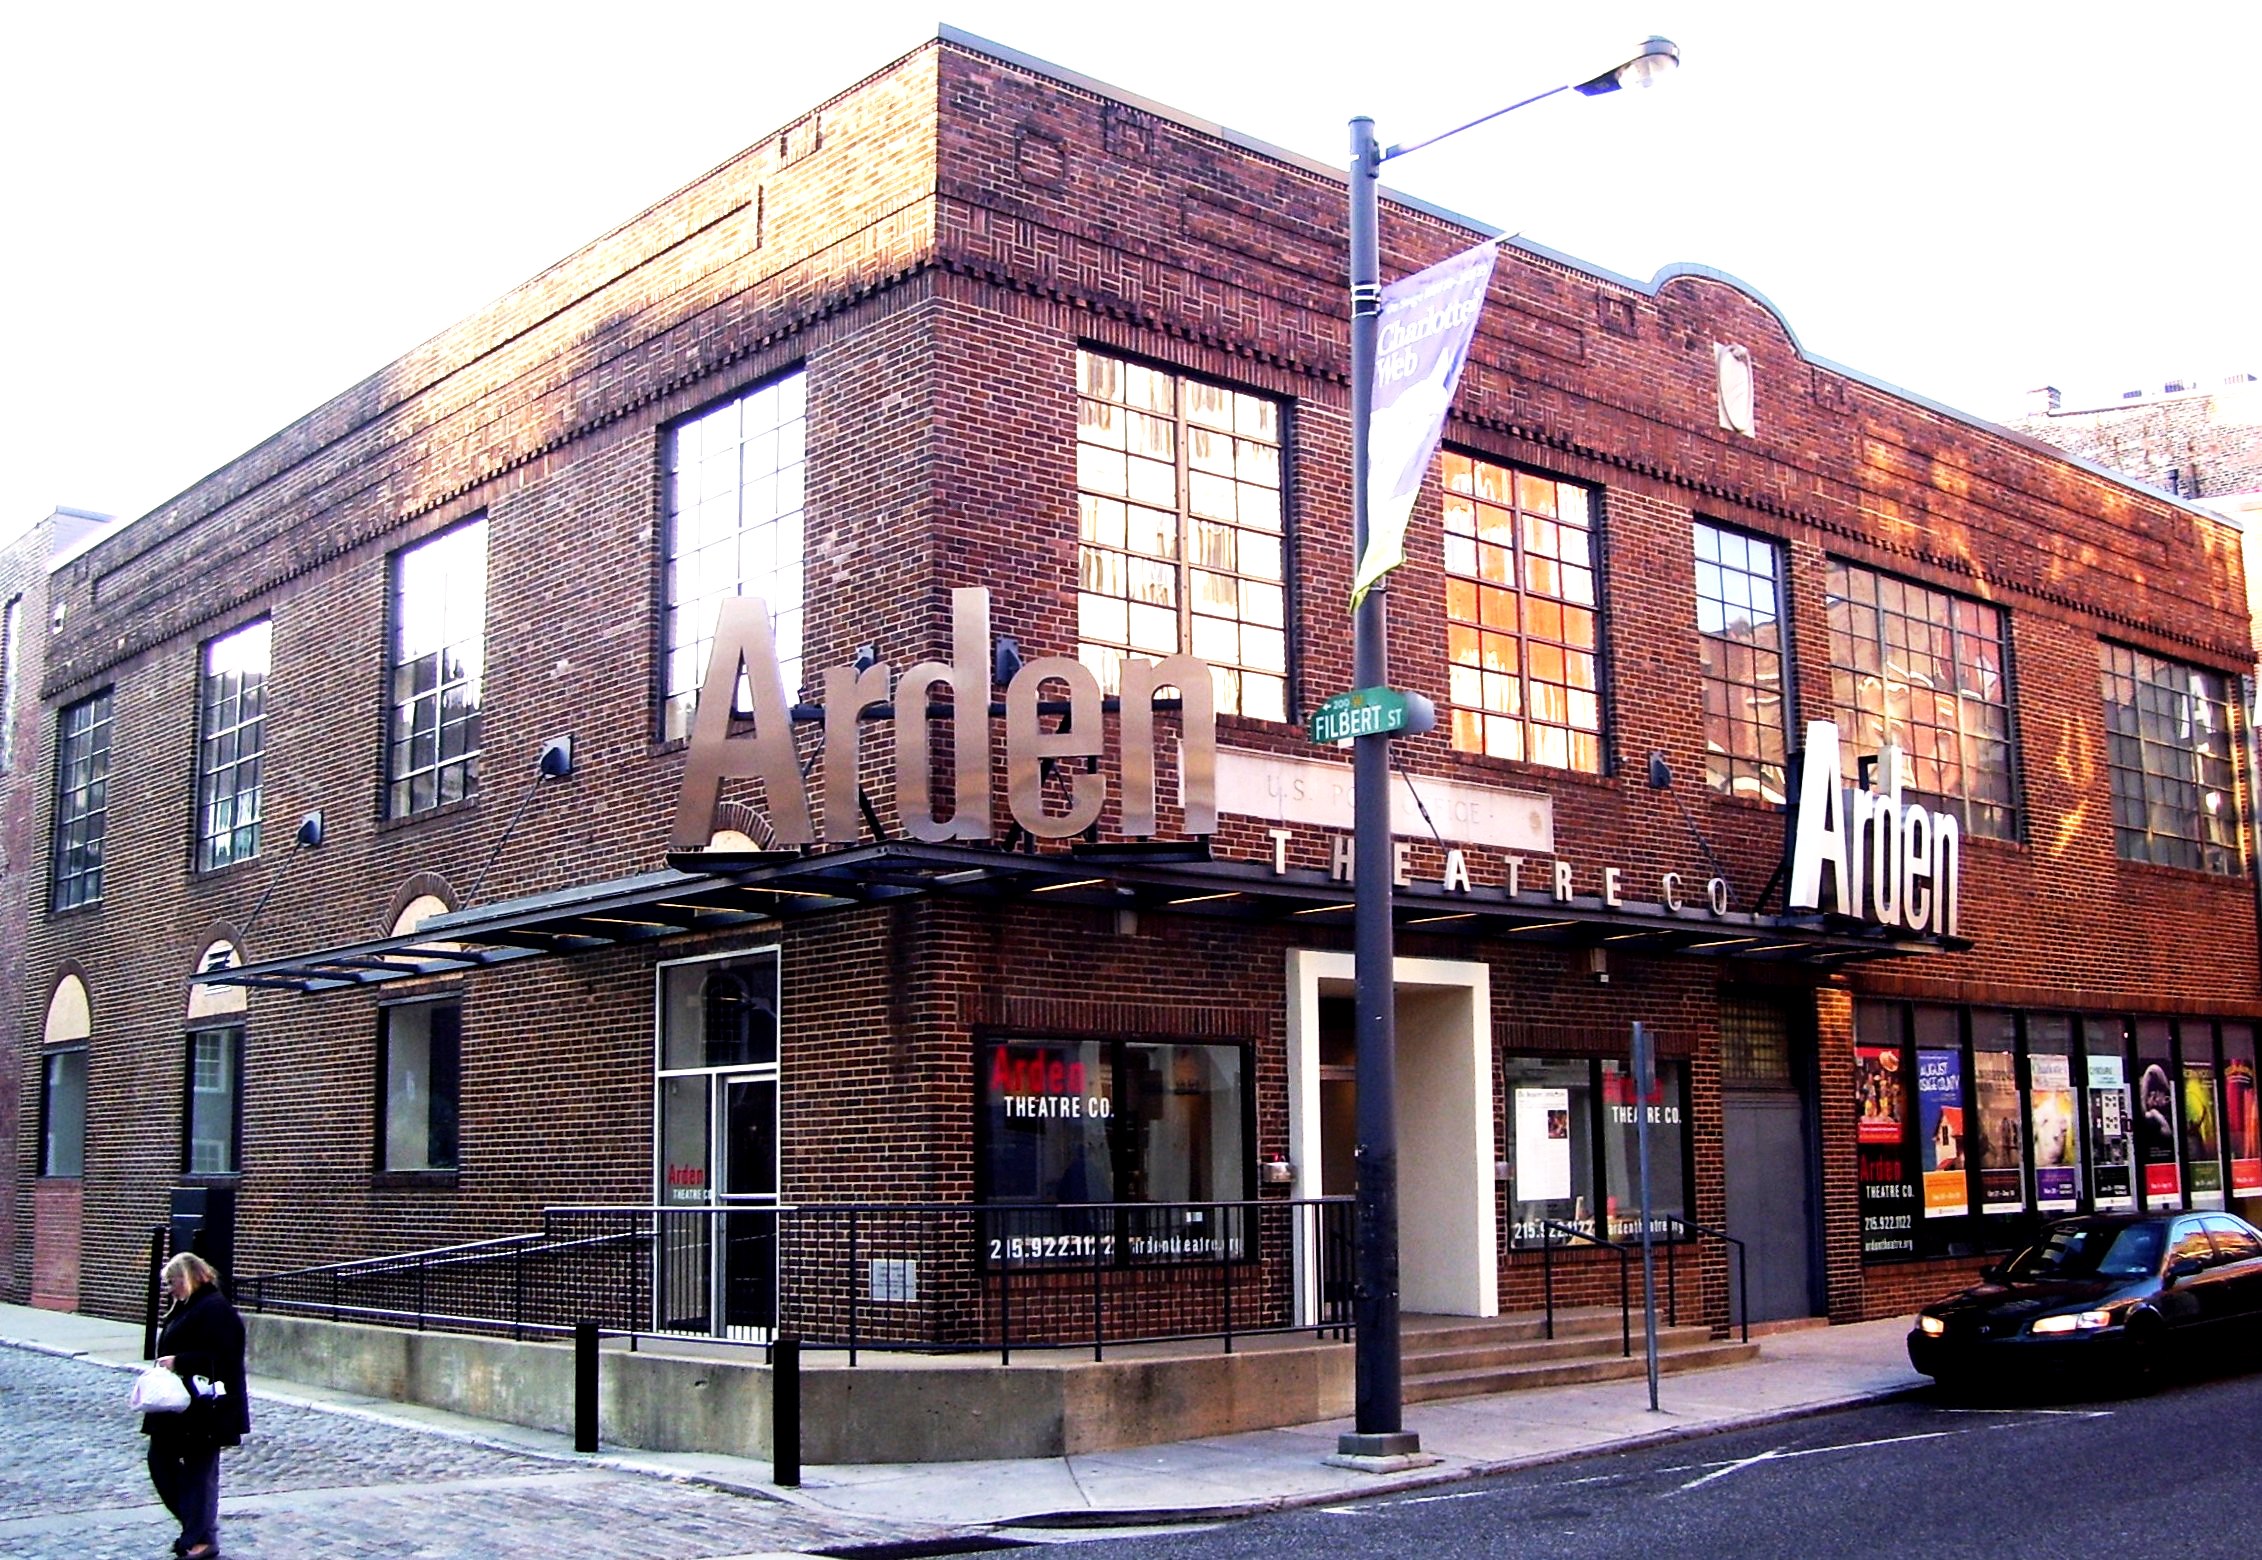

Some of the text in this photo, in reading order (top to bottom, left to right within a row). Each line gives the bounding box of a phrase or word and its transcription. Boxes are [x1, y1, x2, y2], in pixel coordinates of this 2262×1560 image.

[1376, 347, 1418, 387] Web
[670, 587, 1216, 845] Arden
[1332, 698, 1350, 710] 200
[1315, 705, 1402, 740] FILBERT ST
[1790, 720, 1960, 937] Arden
[1268, 829, 1729, 917] THEATRE CO
[990, 1043, 1085, 1093] Arden
[1004, 1096, 1114, 1118] THEATRE CO.
[1611, 1105, 1682, 1124] THEARE CO.
[668, 1163, 704, 1185] Arden
[1860, 1154, 1903, 1182] Arden
[672, 1188, 702, 1200] THEATRE
[1866, 1184, 1900, 1199] THEATRE
